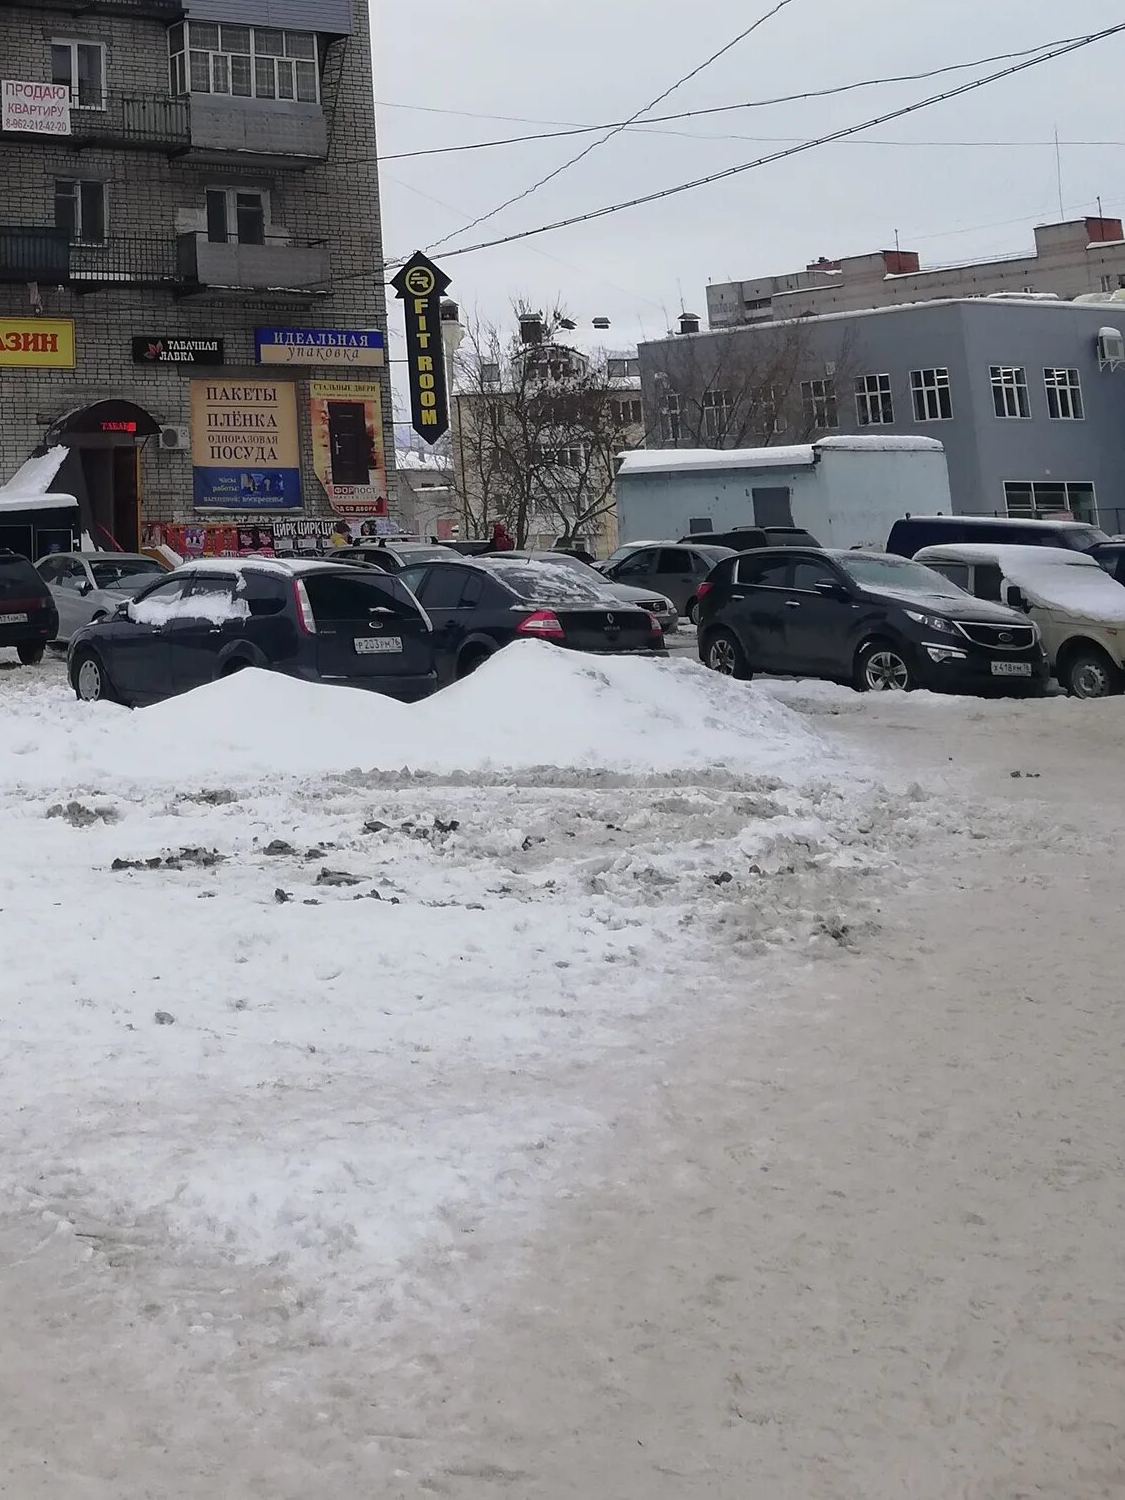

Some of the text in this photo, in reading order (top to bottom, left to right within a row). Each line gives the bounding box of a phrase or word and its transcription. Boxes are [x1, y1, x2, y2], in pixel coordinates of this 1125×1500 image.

[5, 82, 66, 100] ПРОДАЮ
[7, 102, 65, 117] КВАРТИРУ
[167, 340, 218, 351] ТАБАЧНАЯ
[274, 331, 369, 347] ИДЕАЛЬНАЯ
[159, 351, 195, 361] ЛАВКА
[286, 345, 360, 362] упаковка
[414, 298, 438, 425] FIT ROOM
[206, 387, 277, 402] ПАКЕТЫ
[313, 383, 376, 393] СТАЛЬНЫЕ ДВЕРИ
[207, 410, 278, 428] ПЛЁНКА
[207, 435, 279, 445] ОДНОРАЗОВАЯ
[210, 446, 278, 463] ПОСУДА
[273, 521, 297, 537] ЦИРК
[297, 521, 321, 536] ЦИРК
